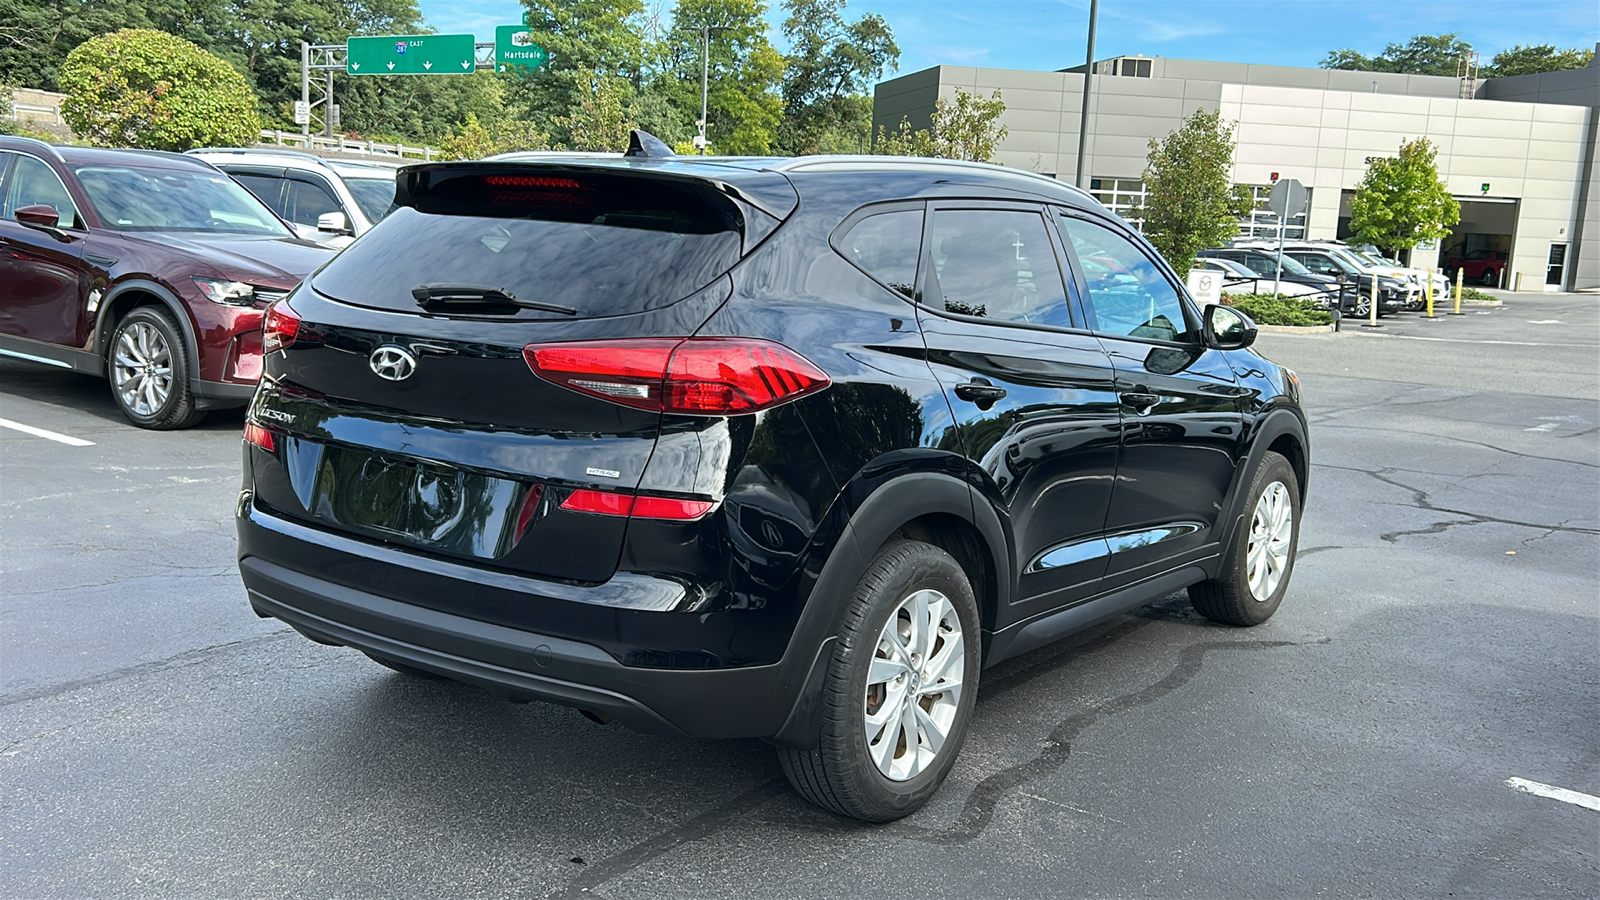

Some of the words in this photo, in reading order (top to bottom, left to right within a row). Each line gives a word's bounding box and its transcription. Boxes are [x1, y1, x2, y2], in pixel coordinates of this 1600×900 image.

[396, 45, 407, 53] 287
[504, 51, 541, 59] Hartsdale
[588, 469, 617, 477] HTRAC
